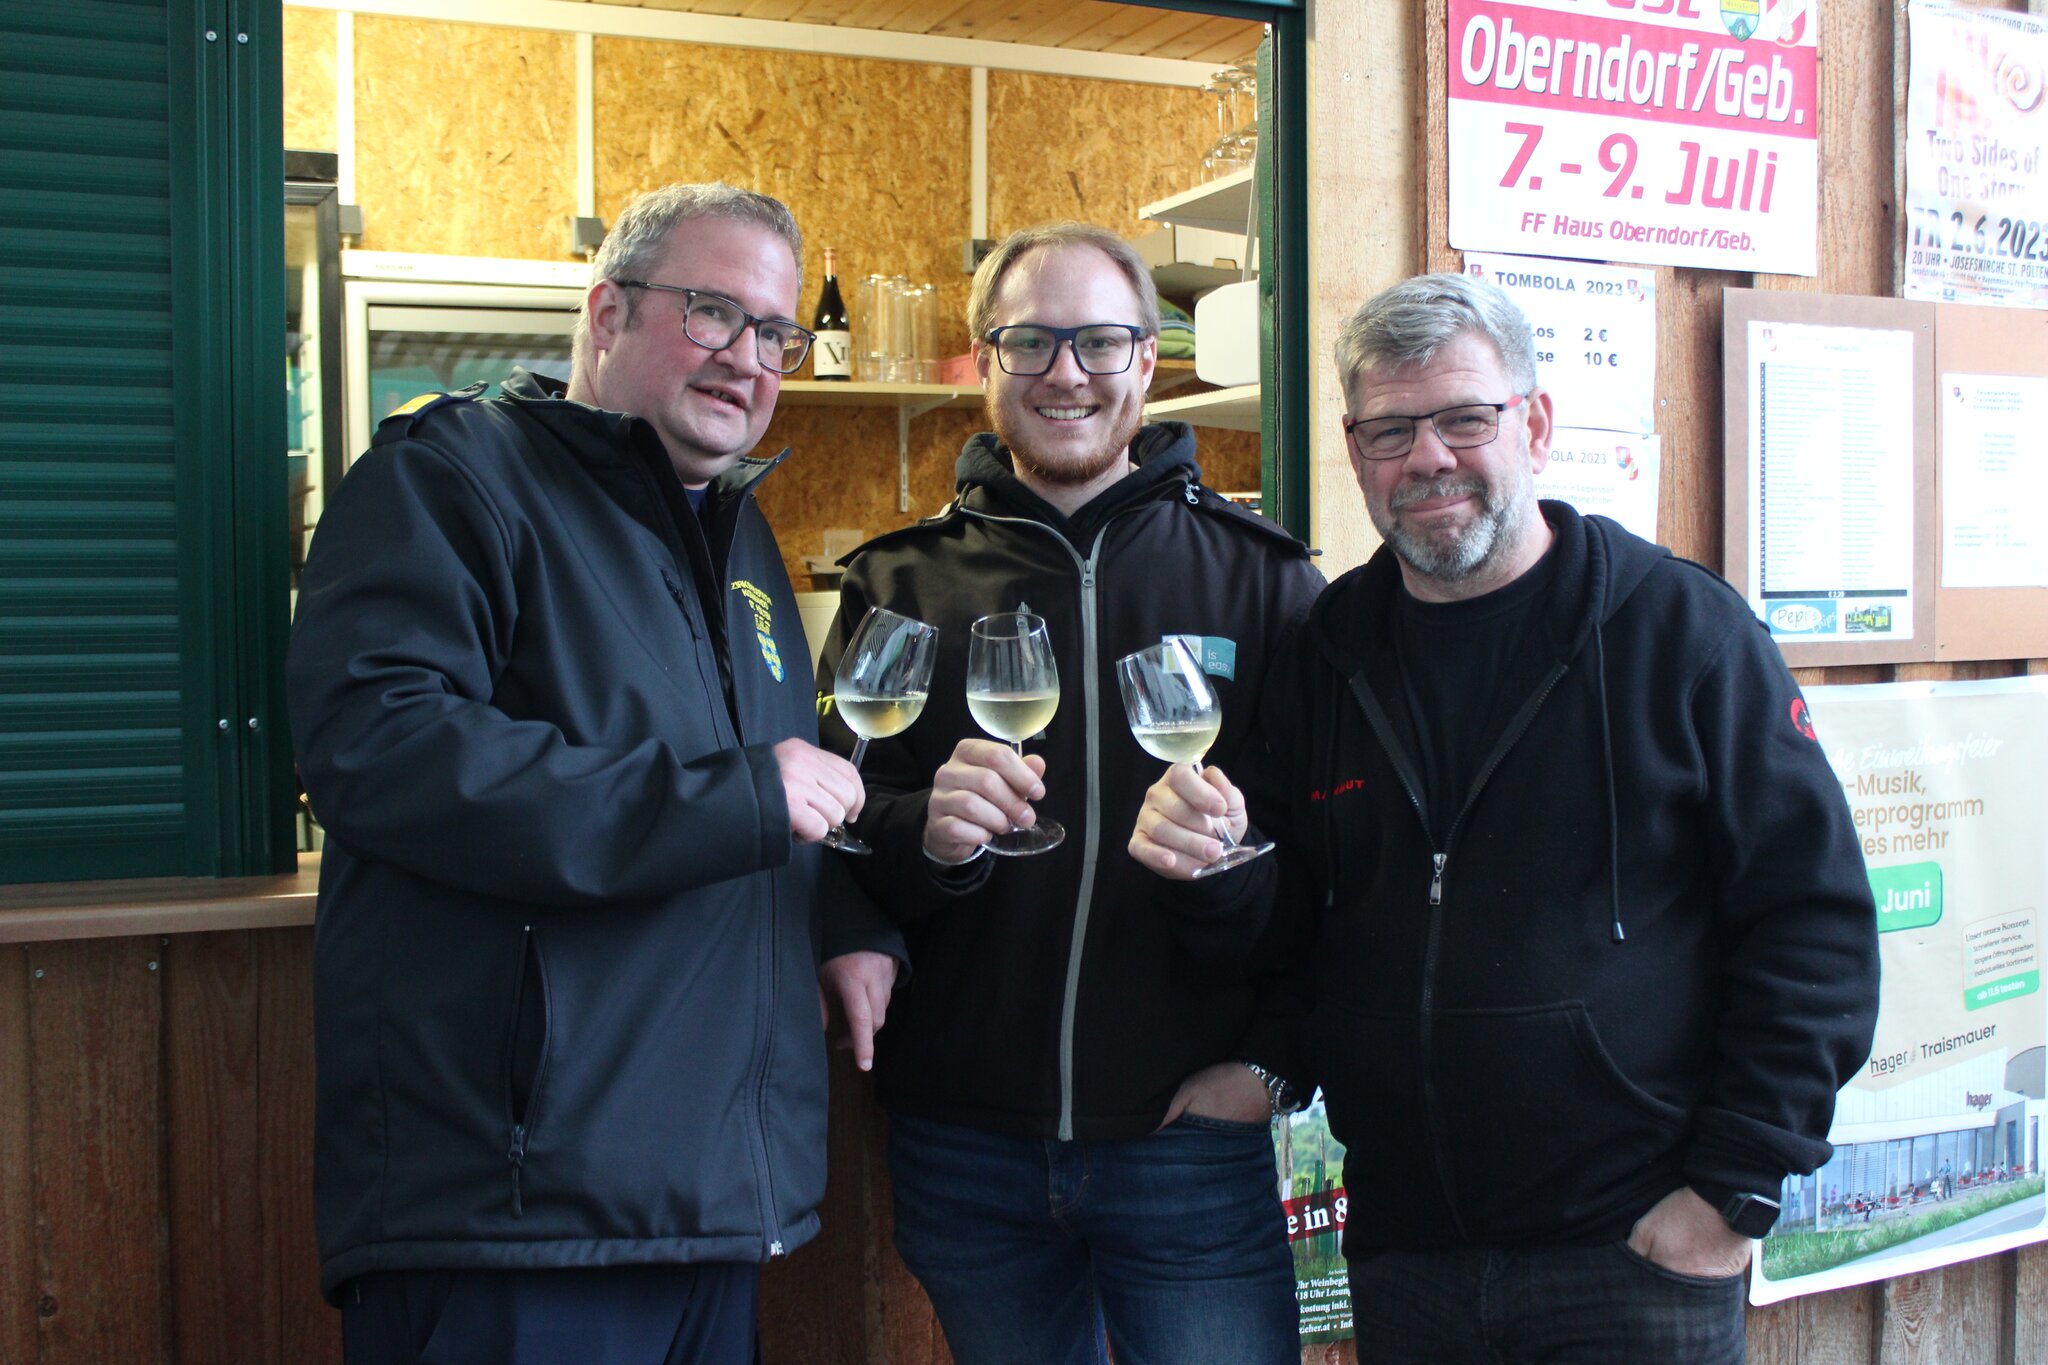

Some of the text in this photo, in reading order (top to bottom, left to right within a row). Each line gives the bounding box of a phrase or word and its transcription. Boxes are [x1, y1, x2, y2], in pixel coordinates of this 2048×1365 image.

[1461, 14, 1804, 125] Oberndorf/Geb.
[1972, 135, 2017, 171] Sides
[2024, 147, 2039, 174] of
[1665, 140, 1778, 213] Juli
[1938, 166, 1971, 199] One
[1520, 211, 1755, 251] FF Haus Oberndorf/Geb.
[1912, 251, 1923, 265] 20
[1925, 252, 1941, 267] UHR
[1950, 255, 2005, 274] JOSEFSKIRCHE
[1495, 271, 1623, 296] TOMBOLA 2023
[1532, 327, 1608, 342] os 2 €
[1536, 351, 1618, 367] se 10 €
[1548, 450, 1607, 464] OLA 2023
[1207, 648, 1217, 660] is
[1840, 770, 1927, 797] -Musik,
[1849, 798, 1984, 833] erprogramm
[1858, 827, 1949, 856] les mehr
[1881, 881, 1931, 913] Juni
[2001, 919, 2030, 931] Konzept
[1870, 1024, 1996, 1074] hager Traismauer
[1966, 1091, 1993, 1111] hager
[1286, 1215, 1299, 1235] e
[1304, 1205, 1330, 1231] in
[1300, 1291, 1308, 1300] 18
[1310, 1289, 1325, 1299] Uhr
[1300, 1299, 1349, 1314] kostung inkl.
